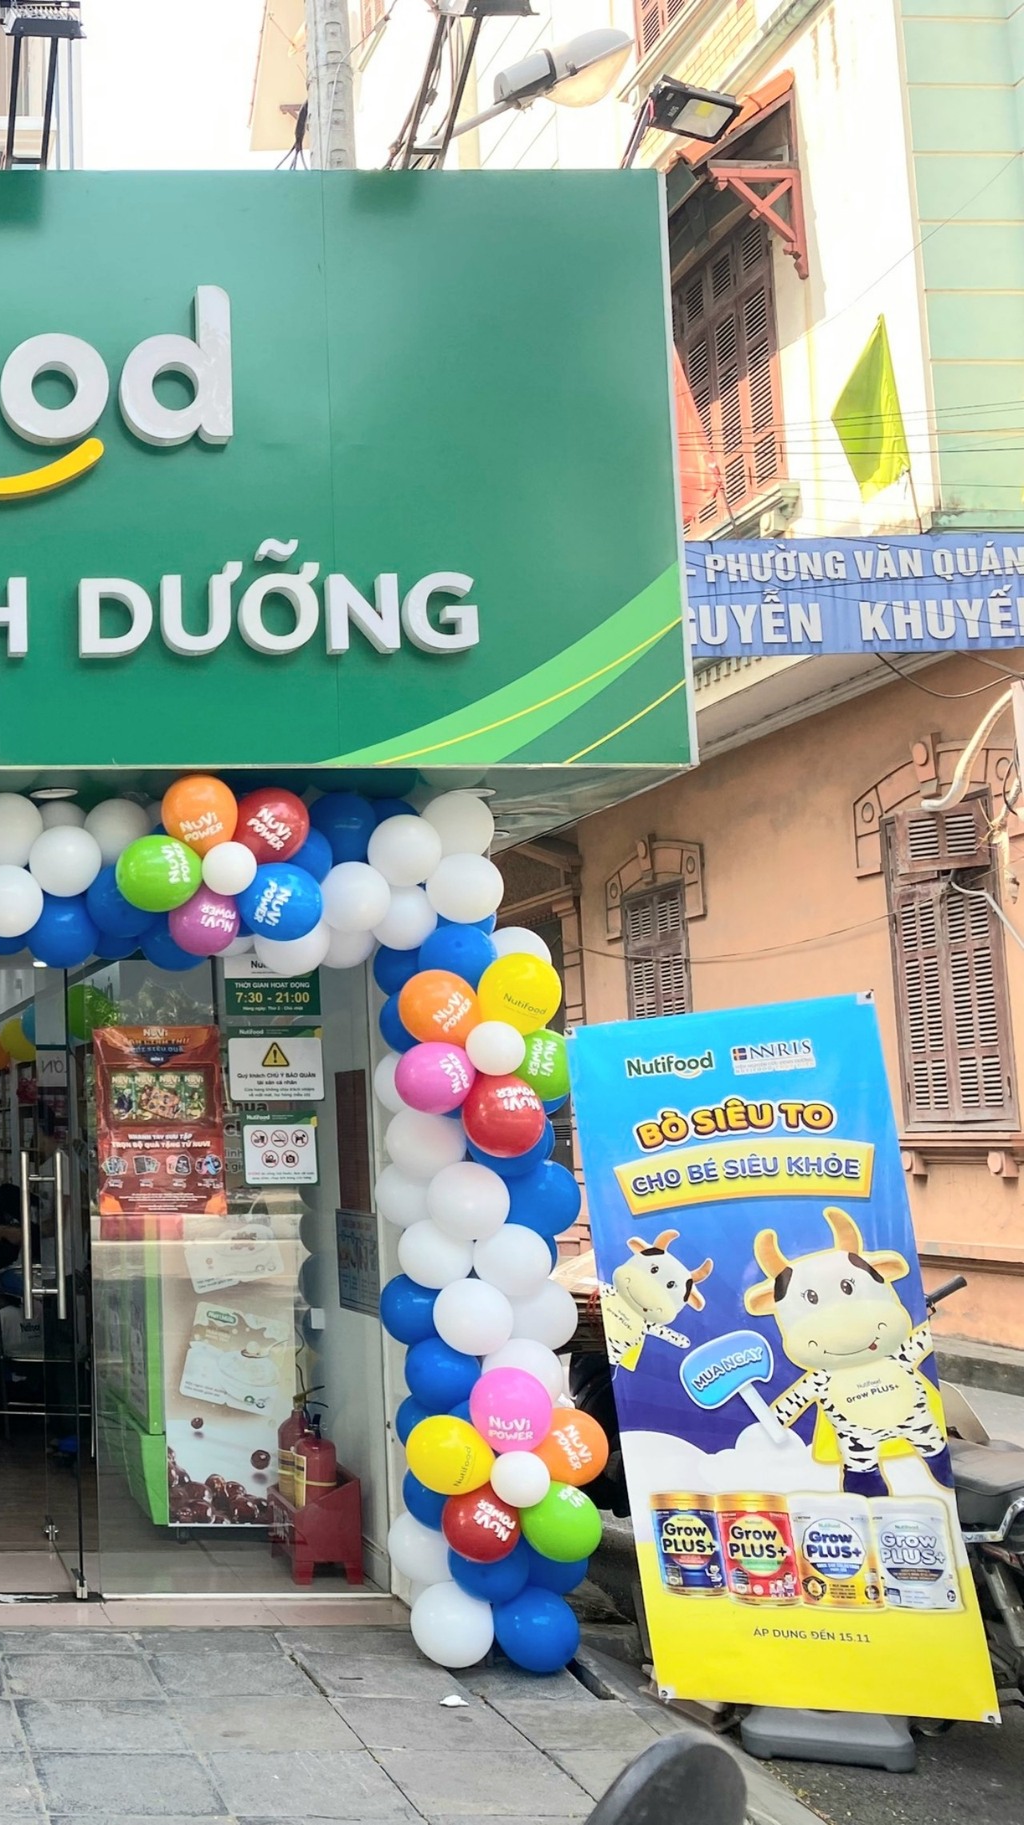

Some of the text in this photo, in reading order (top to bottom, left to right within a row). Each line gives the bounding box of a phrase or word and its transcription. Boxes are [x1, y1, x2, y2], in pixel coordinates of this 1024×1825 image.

[705, 544, 846, 582] PHƯỜNG
[853, 543, 923, 579] VĂN
[78, 539, 480, 659] DƯỠNG
[859, 584, 1024, 642] KHUYẾ
[184, 821, 224, 842] POWER
[247, 818, 286, 850] POWER
[173, 842, 191, 883] POWER
[201, 904, 237, 920] POWER
[254, 880, 277, 924] POWER
[236, 992, 263, 1003] 7:30
[275, 992, 310, 1003] 21:00
[503, 993, 548, 1016] Nutifood
[442, 998, 472, 1033] POWER
[528, 1038, 543, 1077] POWER
[626, 1052, 713, 1076] Nutifood
[447, 1053, 469, 1090] POWER
[496, 1087, 536, 1098] POWER
[637, 1098, 833, 1149] BÒ SIÊU TO
[632, 1152, 861, 1194] CHO BÉ SIÊU KHỎE
[692, 1347, 764, 1389] MUA NGAY
[488, 1429, 533, 1441] POWER
[552, 1430, 583, 1471] POWER
[453, 1446, 472, 1487] Nutifood
[477, 1499, 517, 1531] POWER
[664, 1523, 706, 1536] Grow
[730, 1526, 777, 1540] Grow
[808, 1531, 852, 1544] Grow
[881, 1532, 937, 1548] Grow
[662, 1538, 716, 1553] PLUS+
[729, 1543, 787, 1559] PLUS+
[806, 1544, 862, 1558] PLUS+
[880, 1549, 945, 1566] PLUS+
[753, 1627, 870, 1643] ÁP DỤNG ĐẾN 15.11
